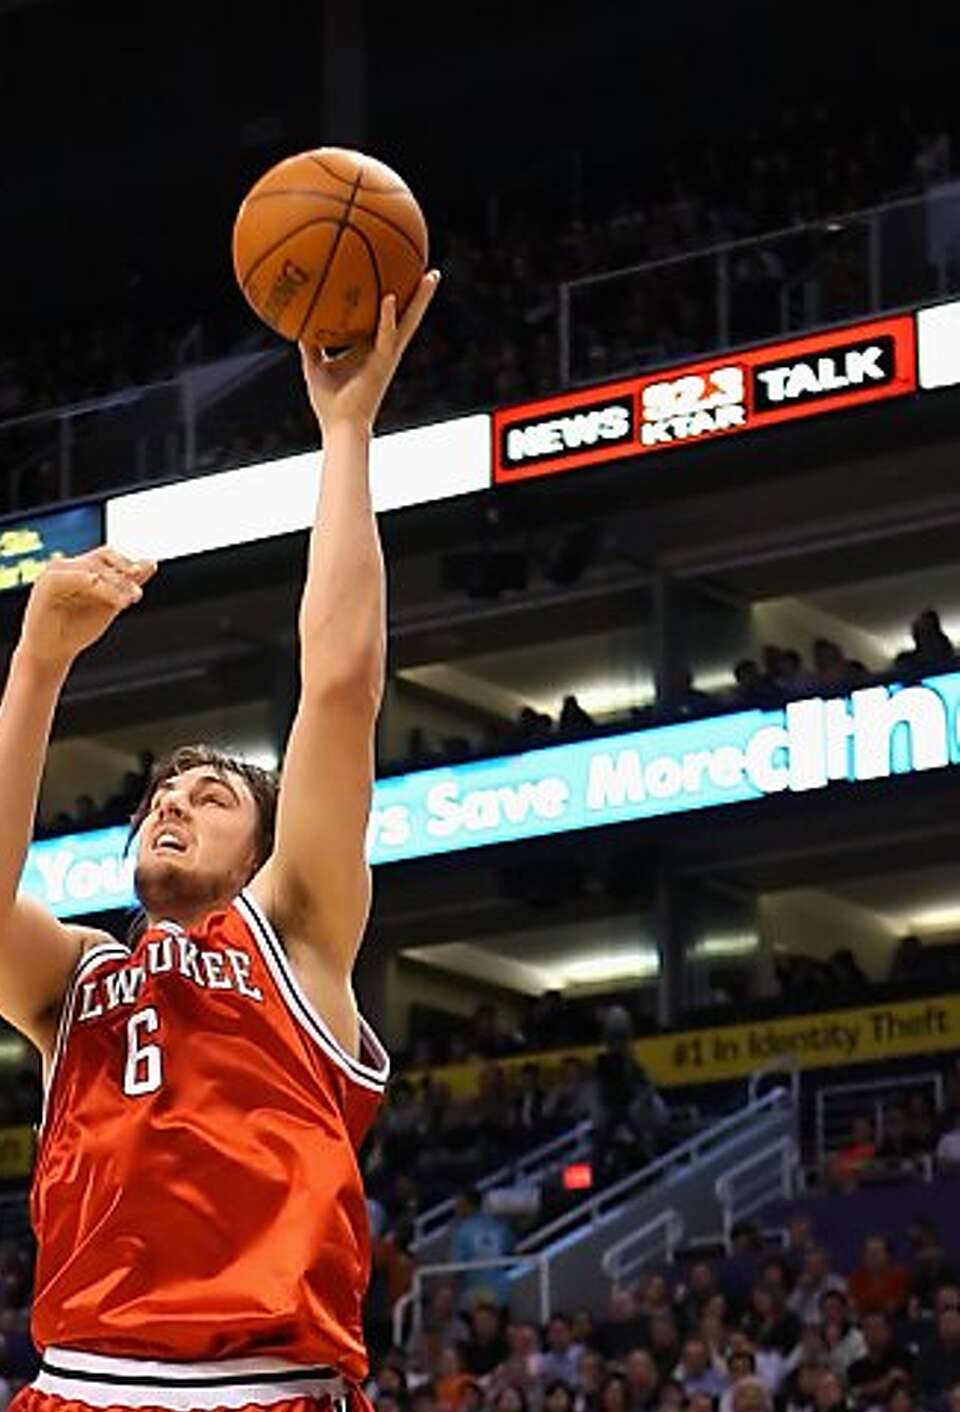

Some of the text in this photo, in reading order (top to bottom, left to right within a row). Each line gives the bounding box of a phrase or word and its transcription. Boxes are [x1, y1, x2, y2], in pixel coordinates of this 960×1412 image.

[757, 345, 886, 402] TALK
[507, 405, 630, 461] NEWS
[641, 405, 747, 446] KTAR
[426, 775, 570, 838] Save
[587, 748, 749, 810] More
[122, 1008, 164, 1097] 6
[672, 1037, 704, 1068] #1
[871, 1001, 949, 1042] Theft
